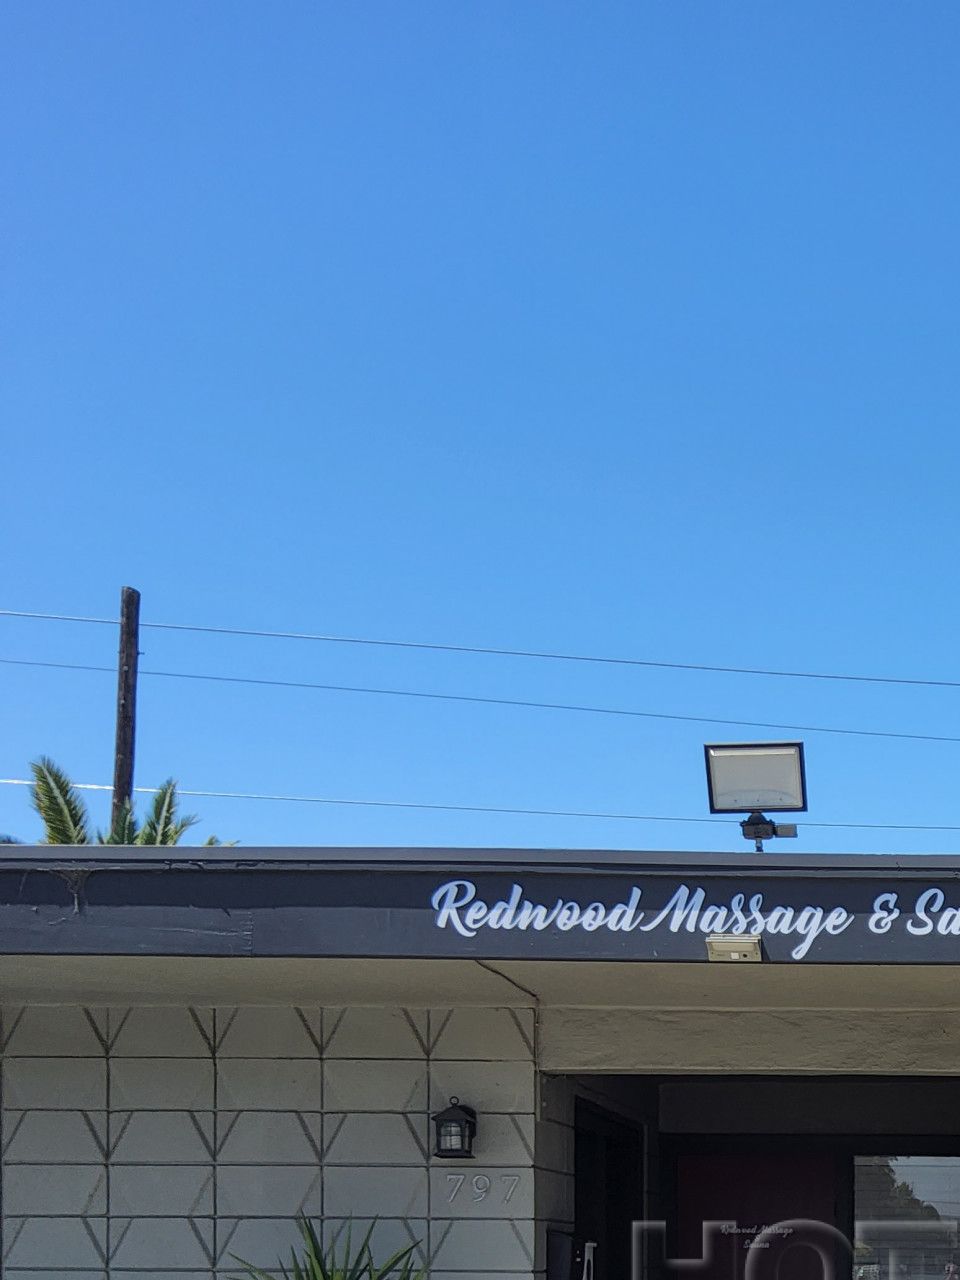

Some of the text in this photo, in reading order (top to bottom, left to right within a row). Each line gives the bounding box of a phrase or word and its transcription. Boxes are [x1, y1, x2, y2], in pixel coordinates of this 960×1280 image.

[431, 880, 643, 937] Redwood
[640, 883, 855, 960] Massage
[868, 892, 900, 934] &
[446, 1174, 520, 1204] 797
